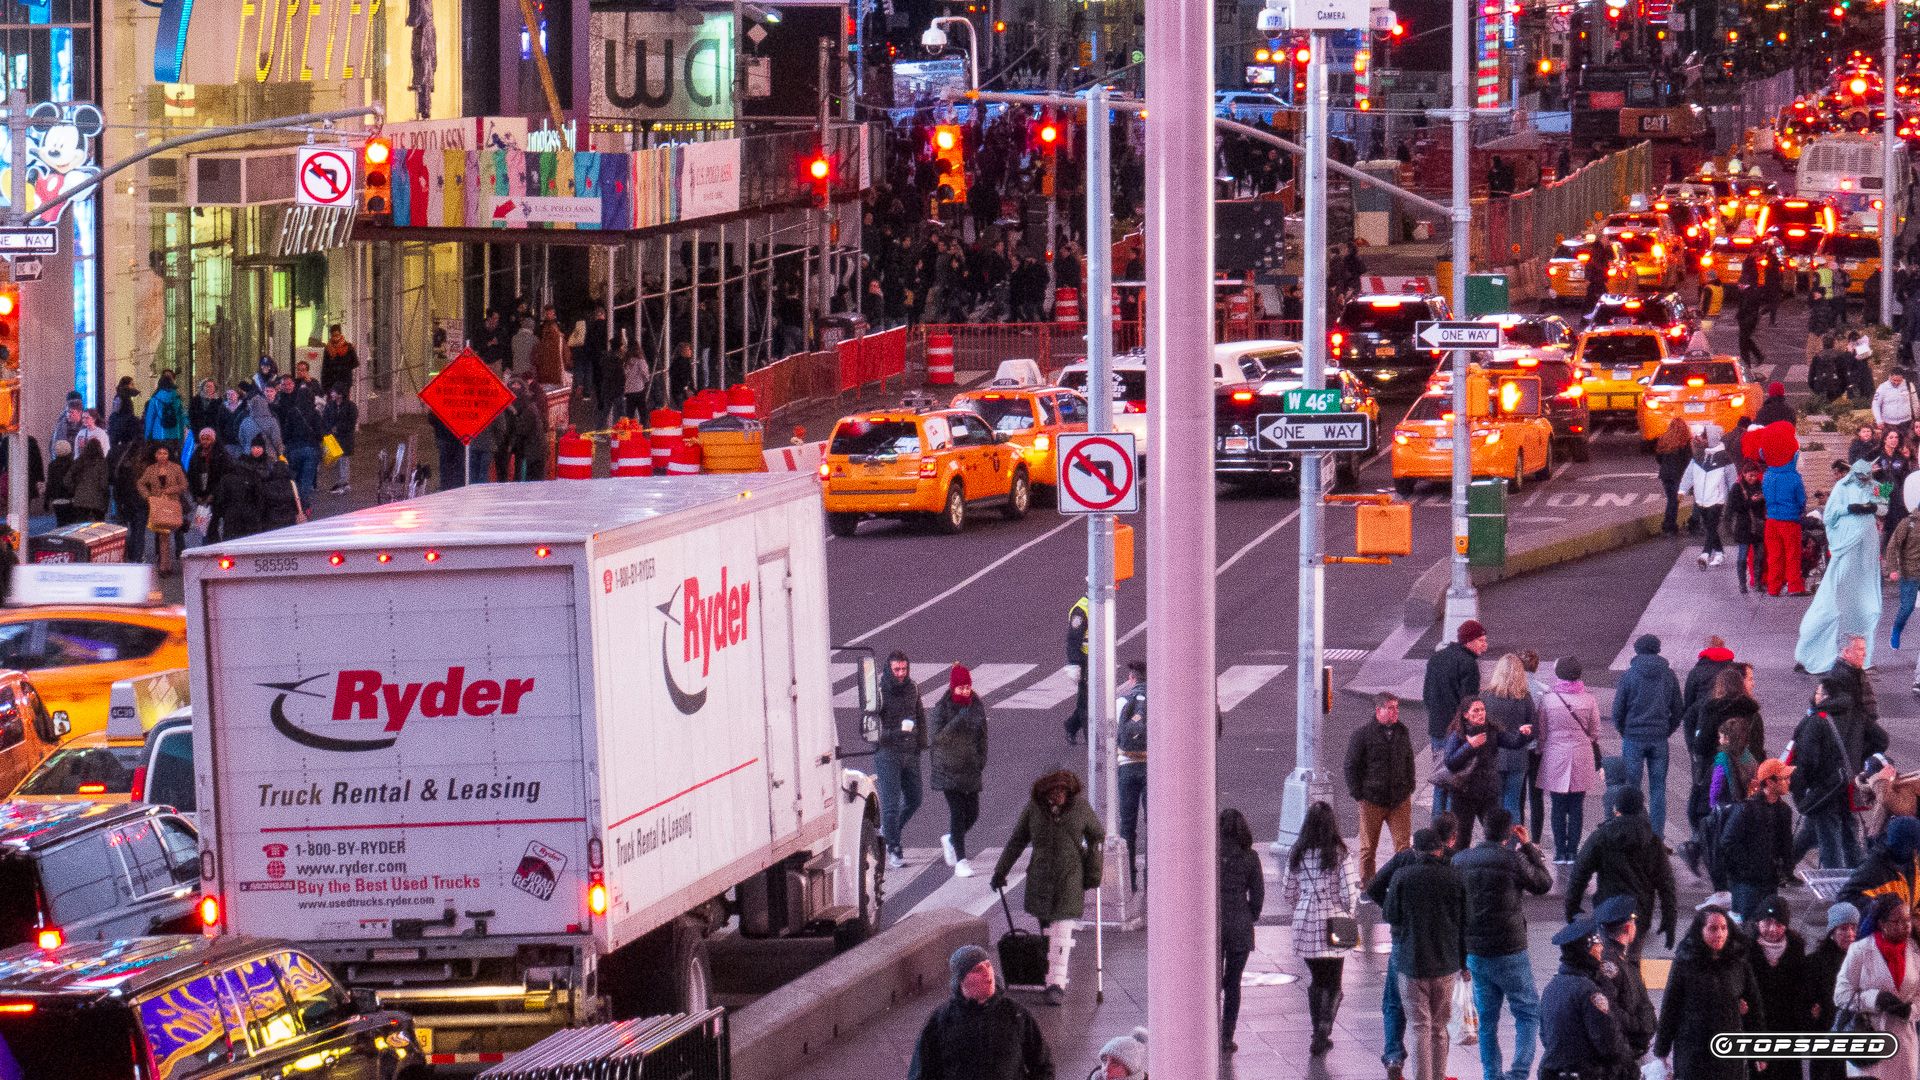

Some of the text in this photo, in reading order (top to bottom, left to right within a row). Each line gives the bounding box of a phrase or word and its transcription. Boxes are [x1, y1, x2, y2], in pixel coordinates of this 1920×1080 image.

[1317, 10, 1346, 21] CAMERA
[1643, 116, 1664, 131] CAT
[0, 234, 49, 246] NE WAY
[1441, 329, 1490, 341] ONE WAY
[1288, 392, 1302, 410] W
[1272, 424, 1359, 440] ONE WAY
[255, 558, 299, 573] 585595
[615, 557, 656, 589] 1-800-BY-RYDER
[684, 566, 751, 678] Ryder
[332, 666, 535, 732] Ryder
[258, 775, 541, 807] Truck Rental & Leasing
[616, 830, 635, 867] Truck
[637, 818, 660, 858] Rental
[668, 808, 692, 842] Leasing
[295, 840, 406, 857] 1-800-BY-RYDER
[296, 860, 407, 876] www.ryder.com
[297, 874, 480, 897] Buy the Best Used Trucks
[513, 873, 552, 900] READY
[299, 896, 435, 910] www.usedtrucks.ryder.com
